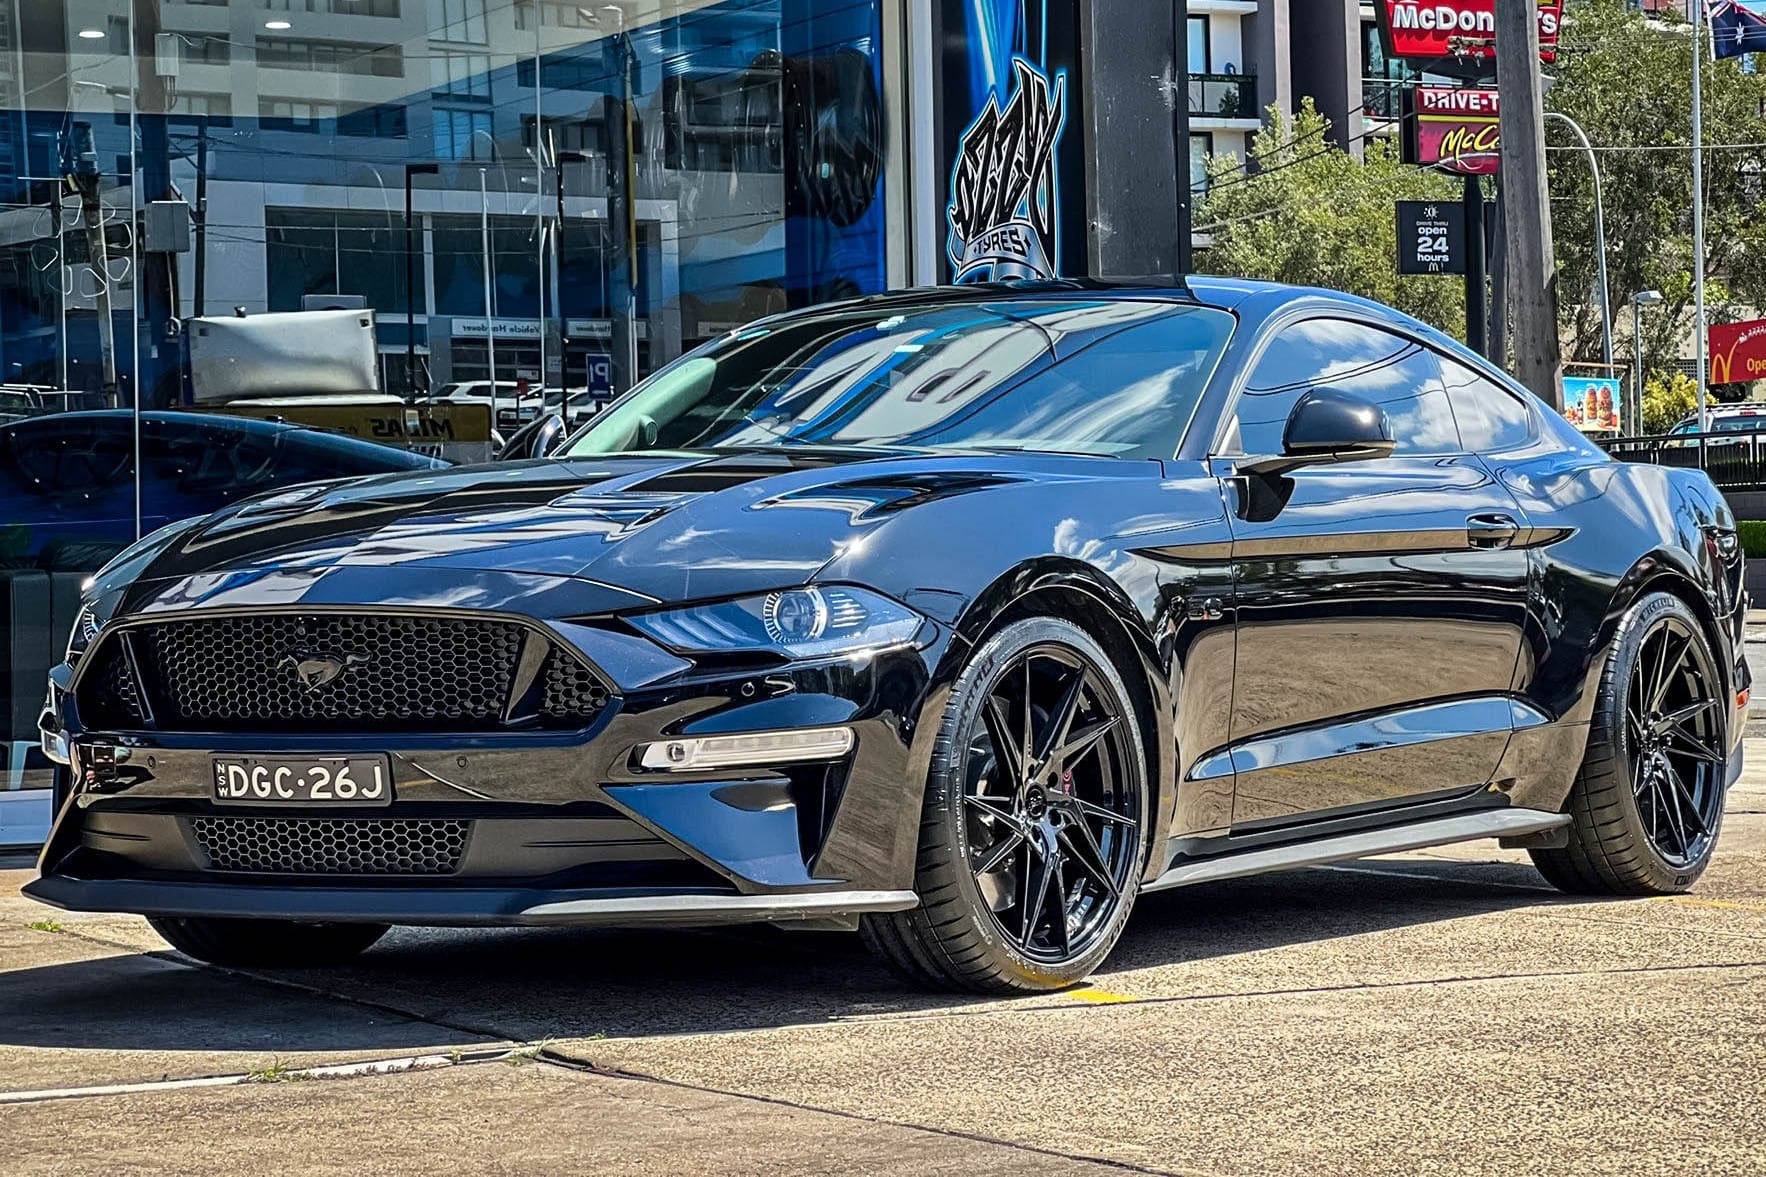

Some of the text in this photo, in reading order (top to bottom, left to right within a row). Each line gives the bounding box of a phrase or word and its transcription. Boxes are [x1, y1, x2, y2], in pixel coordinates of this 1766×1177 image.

[1392, 4, 1557, 34] McDon's
[1417, 227, 1447, 236] open
[975, 228, 1027, 256] TYRES
[1417, 236, 1449, 253] 24
[1417, 253, 1450, 262] hours
